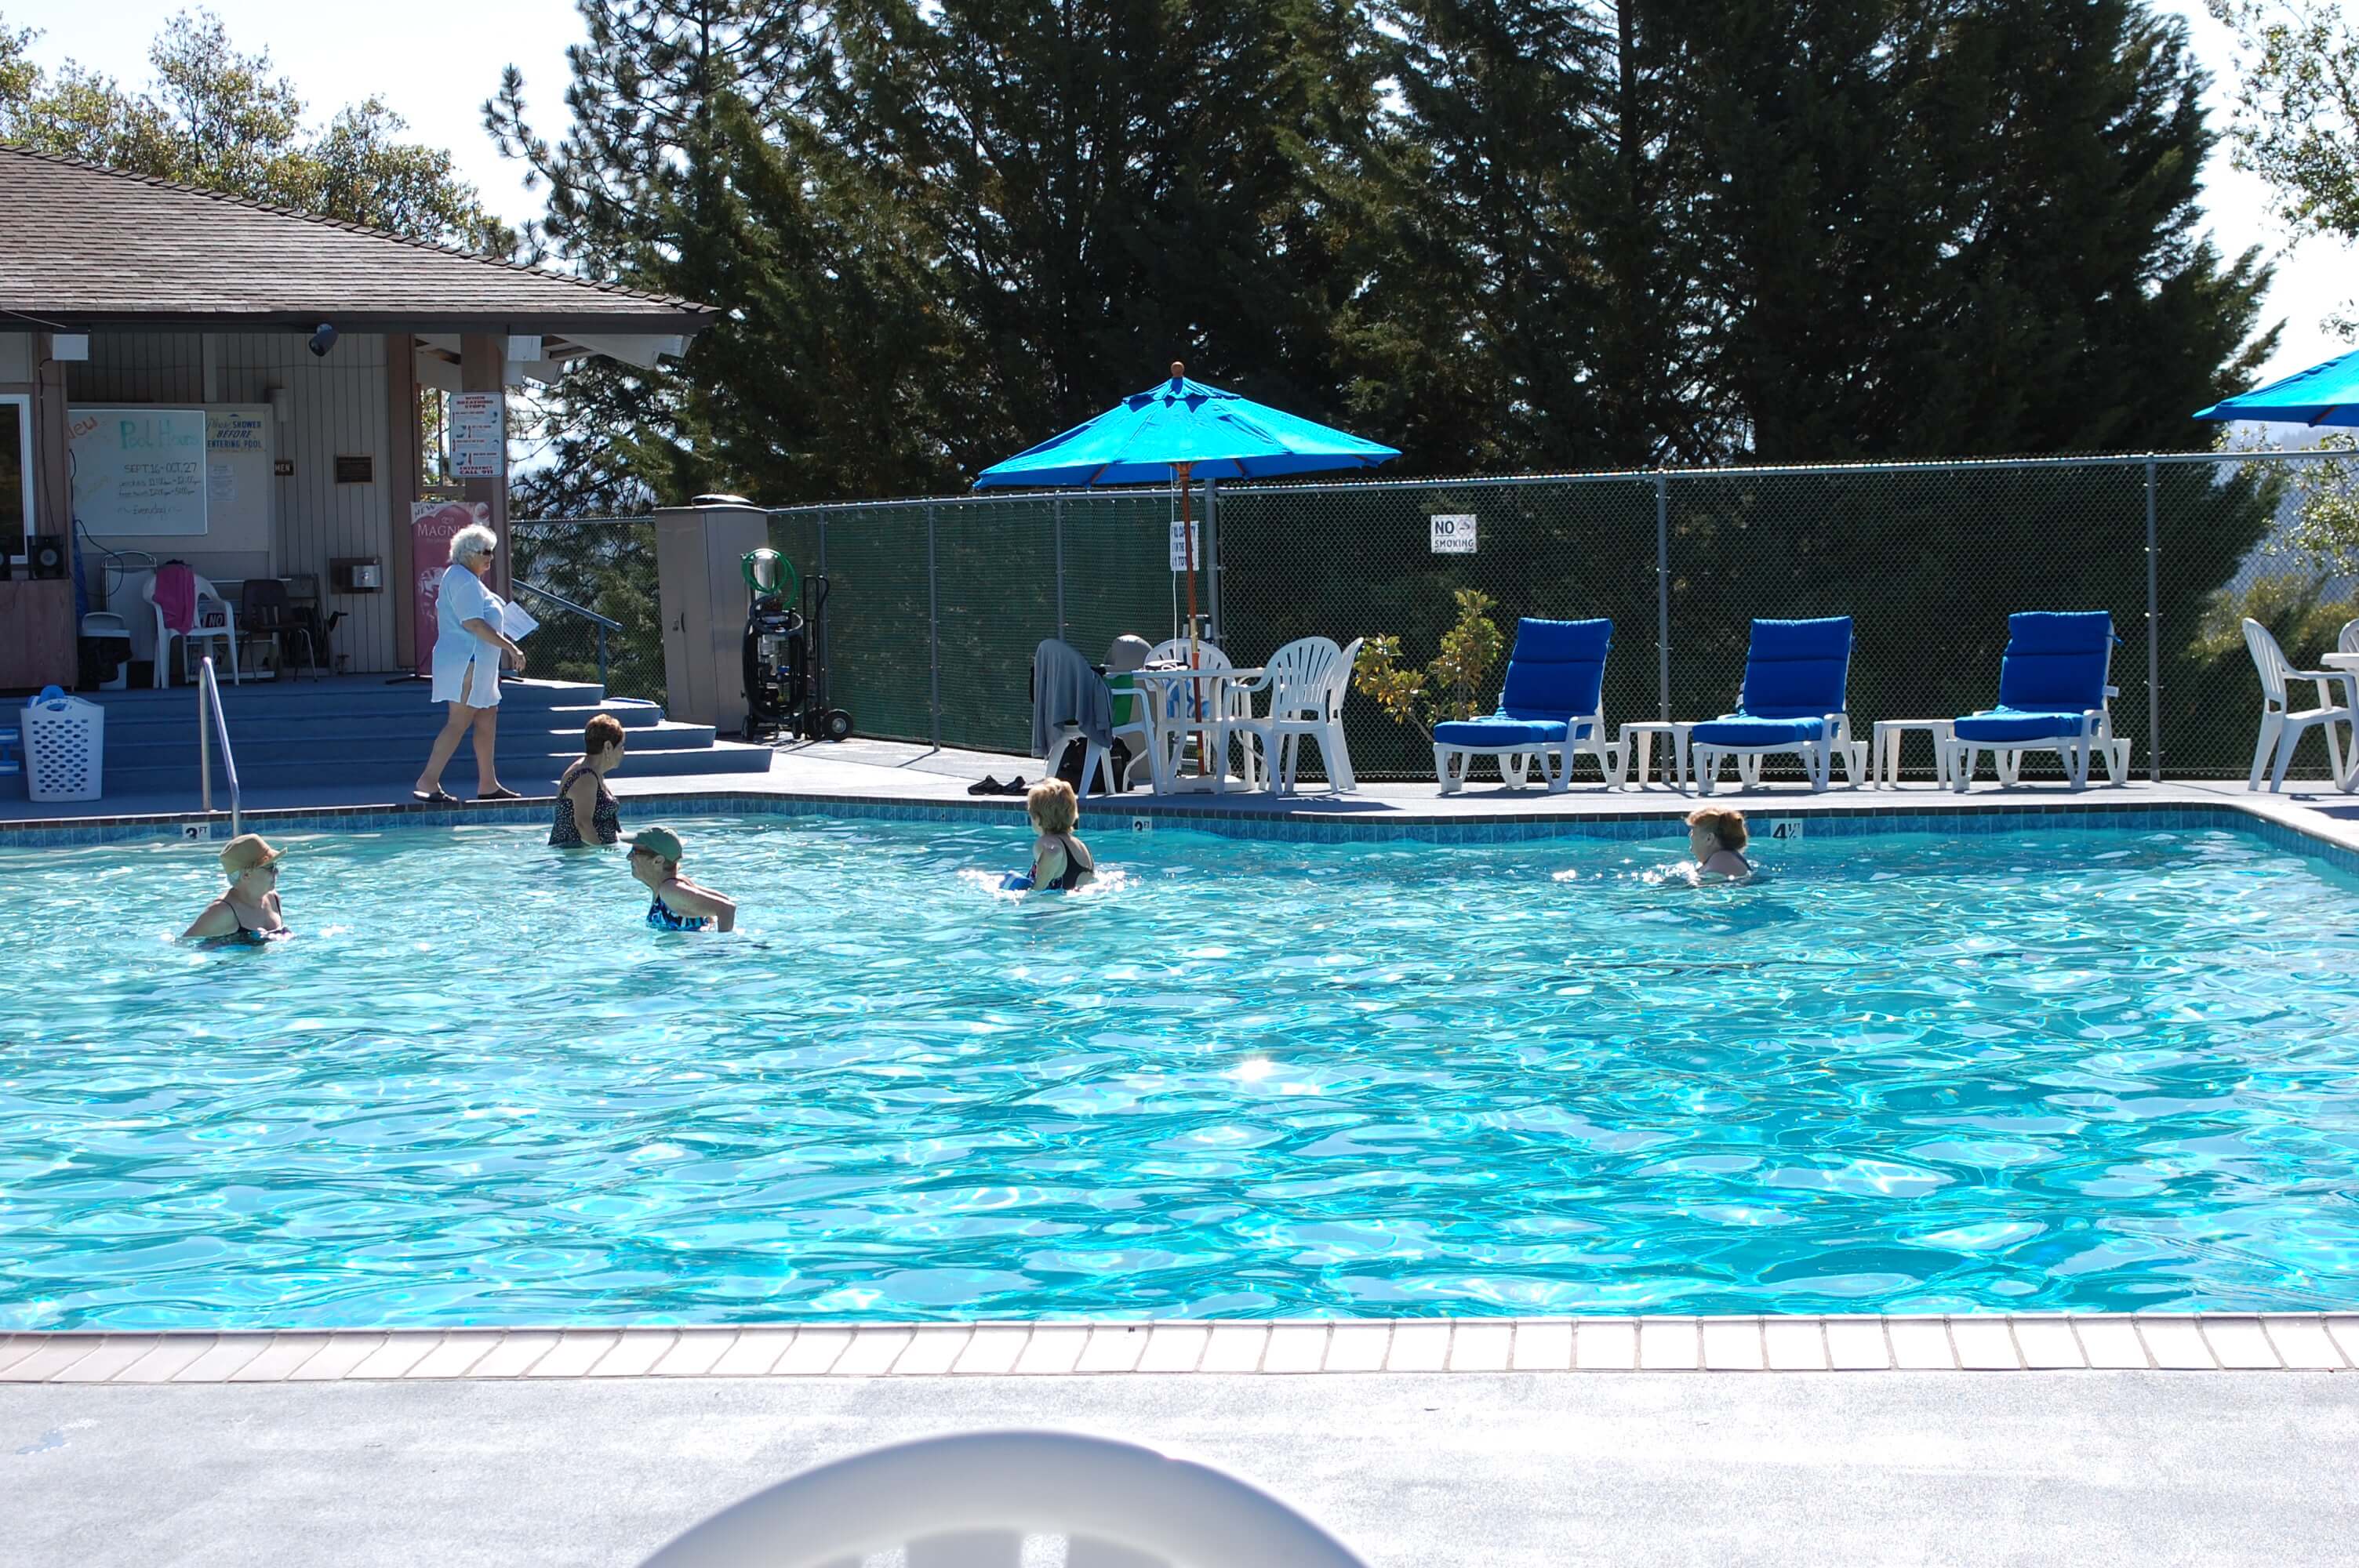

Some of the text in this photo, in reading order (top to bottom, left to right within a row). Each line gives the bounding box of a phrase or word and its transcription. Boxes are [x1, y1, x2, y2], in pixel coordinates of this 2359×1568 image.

[232, 420, 262, 429] SHOWER
[119, 419, 154, 450] Pool
[216, 430, 253, 438] BEFORE
[207, 440, 263, 448] ENTERING POOL
[414, 504, 436, 518] NEW
[417, 523, 460, 538] MAGN
[1434, 521, 1455, 535] NO
[1434, 539, 1474, 548] SMOKING
[209, 614, 224, 626] NO
